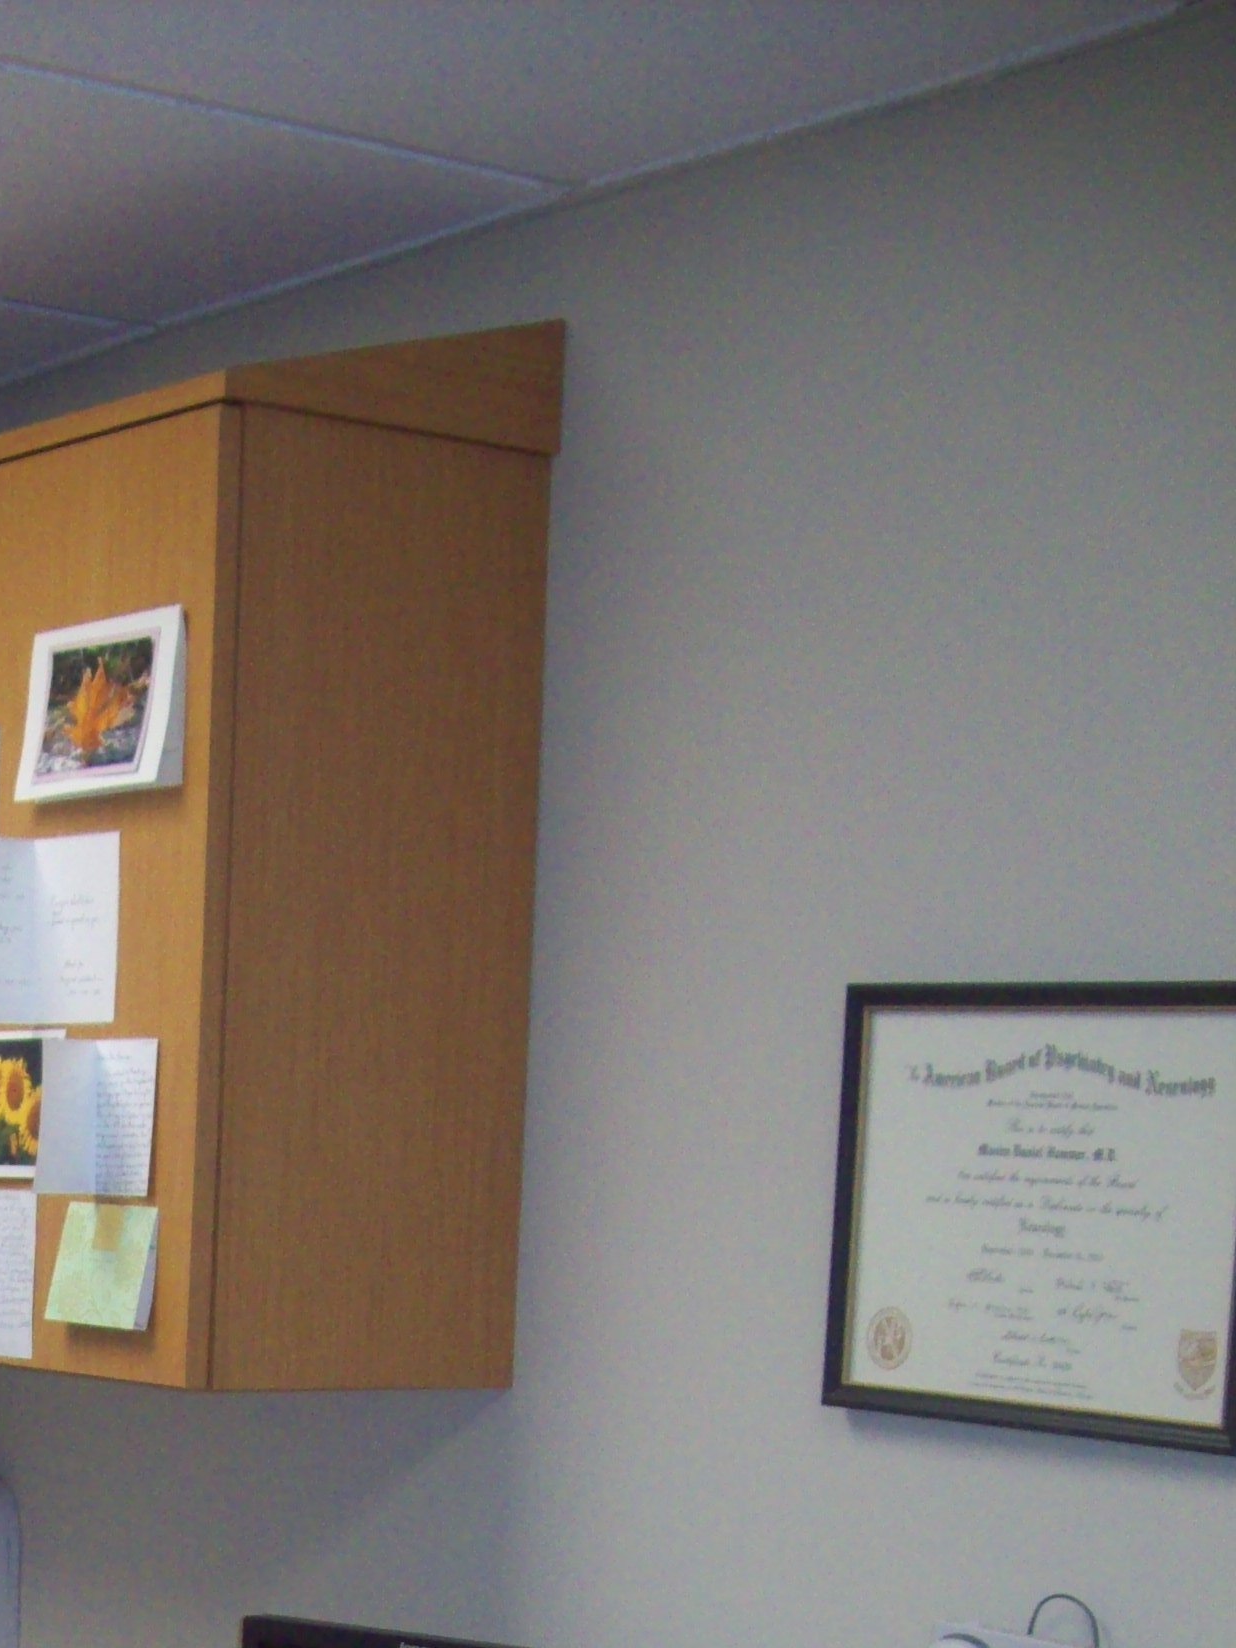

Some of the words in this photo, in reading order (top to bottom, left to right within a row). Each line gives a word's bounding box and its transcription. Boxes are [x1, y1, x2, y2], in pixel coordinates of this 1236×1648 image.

[922, 1062, 981, 1087] American
[985, 1052, 1026, 1083] Board
[1028, 1048, 1043, 1068] of
[1045, 1043, 1115, 1084] Psychiatry
[1118, 1070, 1141, 1090] and
[1144, 1069, 1217, 1098] Neurology
